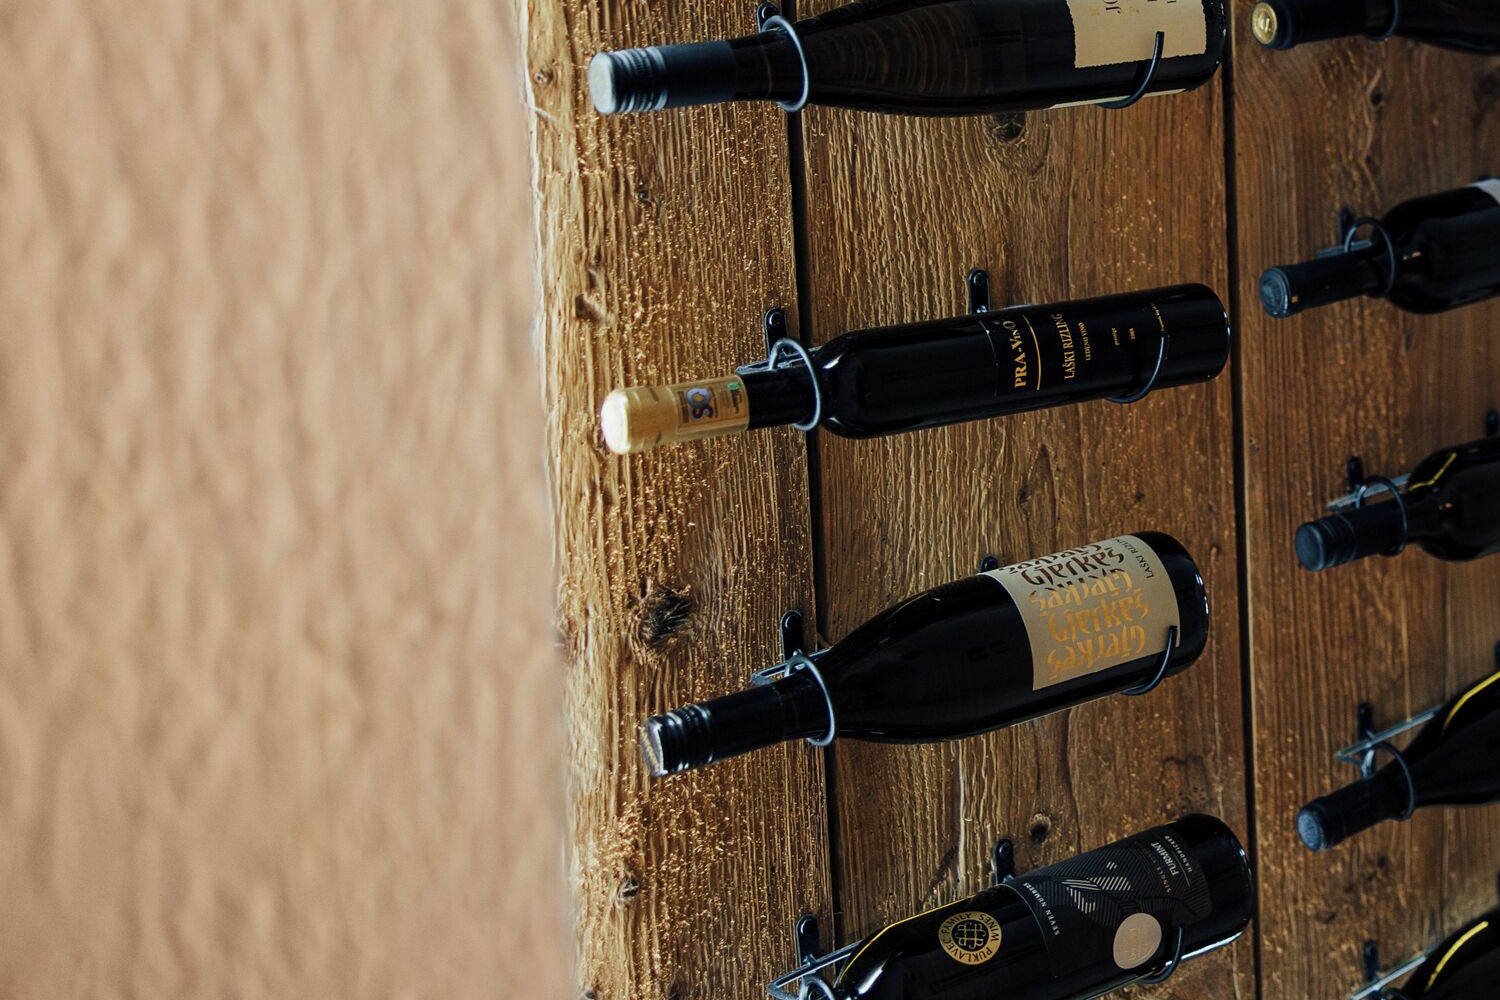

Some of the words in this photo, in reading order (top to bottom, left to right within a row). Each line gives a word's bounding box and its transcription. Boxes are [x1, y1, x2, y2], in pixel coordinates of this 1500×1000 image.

[1051, 313, 1075, 348] RIZLING
[1078, 321, 1088, 336] VINO
[1082, 337, 1092, 361] LEDENO
[1062, 350, 1076, 379] LAŠKI
[1136, 553, 1155, 579] LAŠKI
[1150, 842, 1179, 876] FURMINT
[942, 913, 970, 934] FAMILY
[979, 913, 1000, 942] WINES
[943, 939, 992, 962] PUKLAVEC
